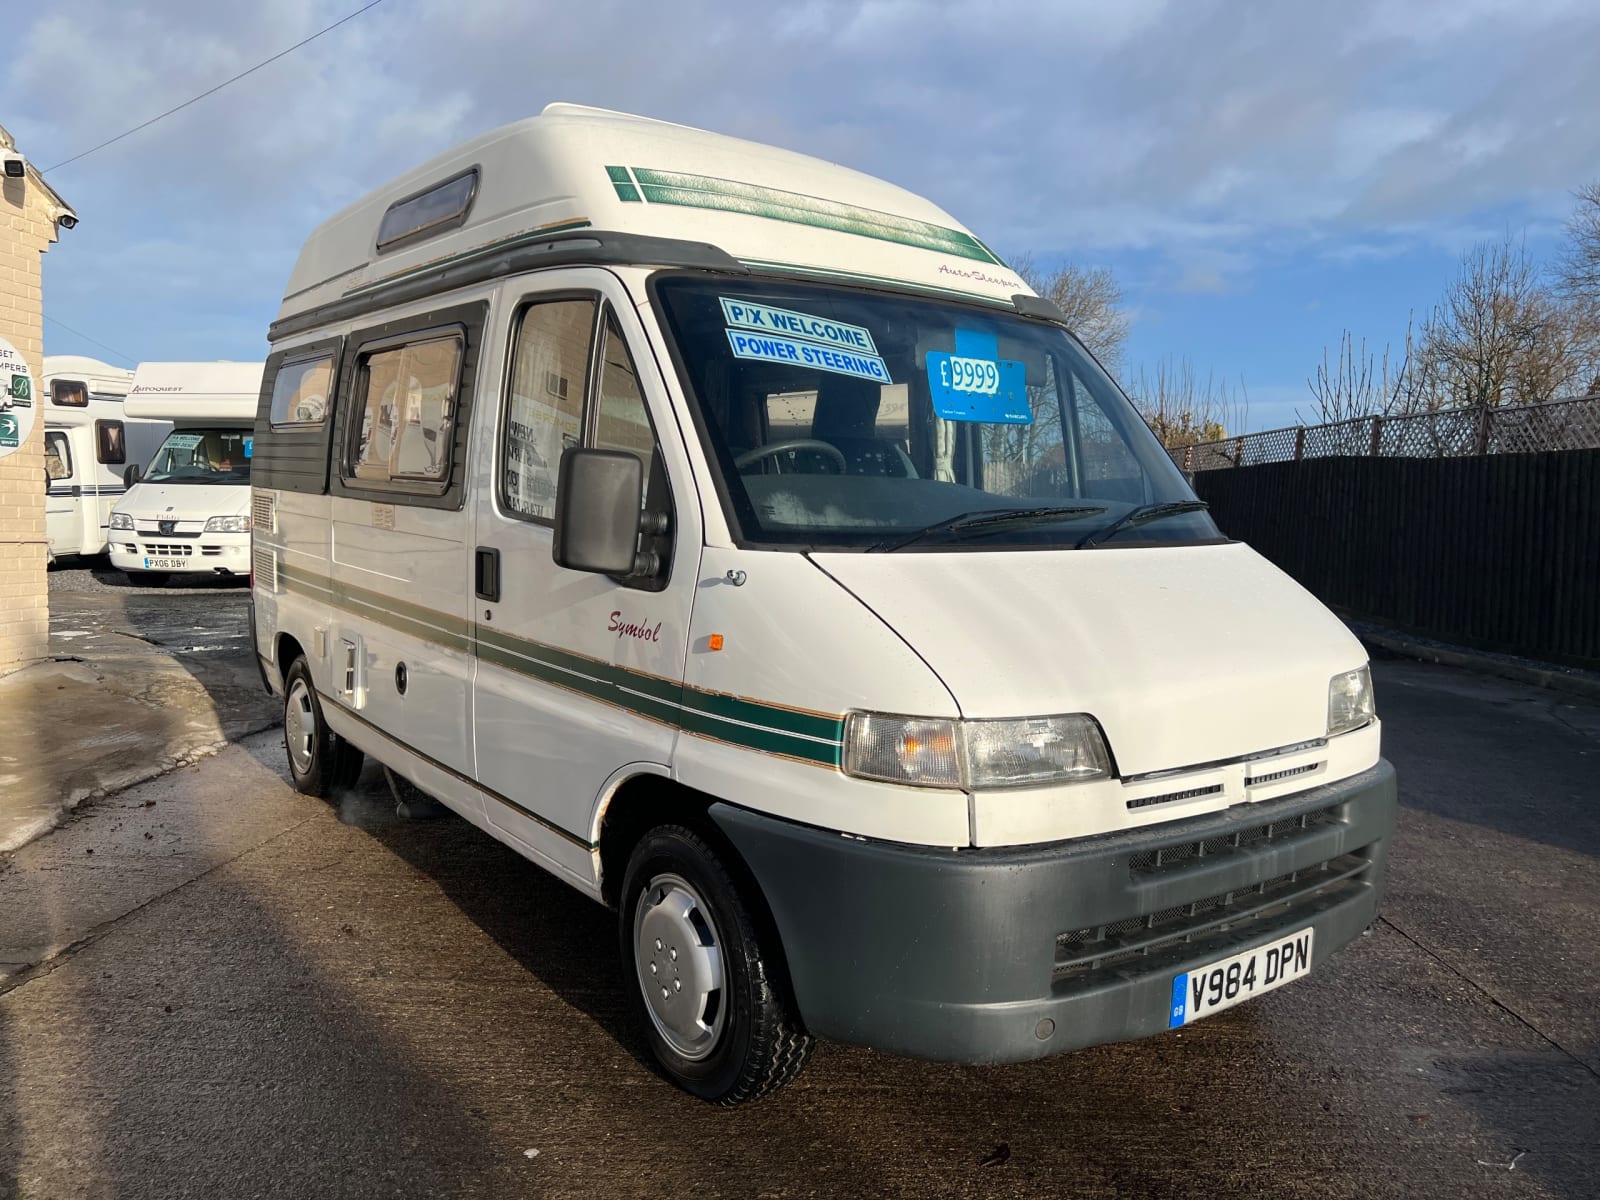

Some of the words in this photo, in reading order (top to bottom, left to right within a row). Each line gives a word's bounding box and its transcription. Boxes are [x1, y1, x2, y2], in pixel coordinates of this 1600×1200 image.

[730, 305, 765, 325] P/X
[768, 312, 867, 348] WELCOME
[735, 336, 800, 360] POWER
[803, 347, 883, 377] STEERING
[149, 559, 169, 567] PX06
[170, 560, 186, 568] DBY
[607, 610, 662, 642] Symbol
[1192, 955, 1256, 1013] V984
[1264, 935, 1309, 985] DPN
[1173, 1005, 1184, 1017] GB
